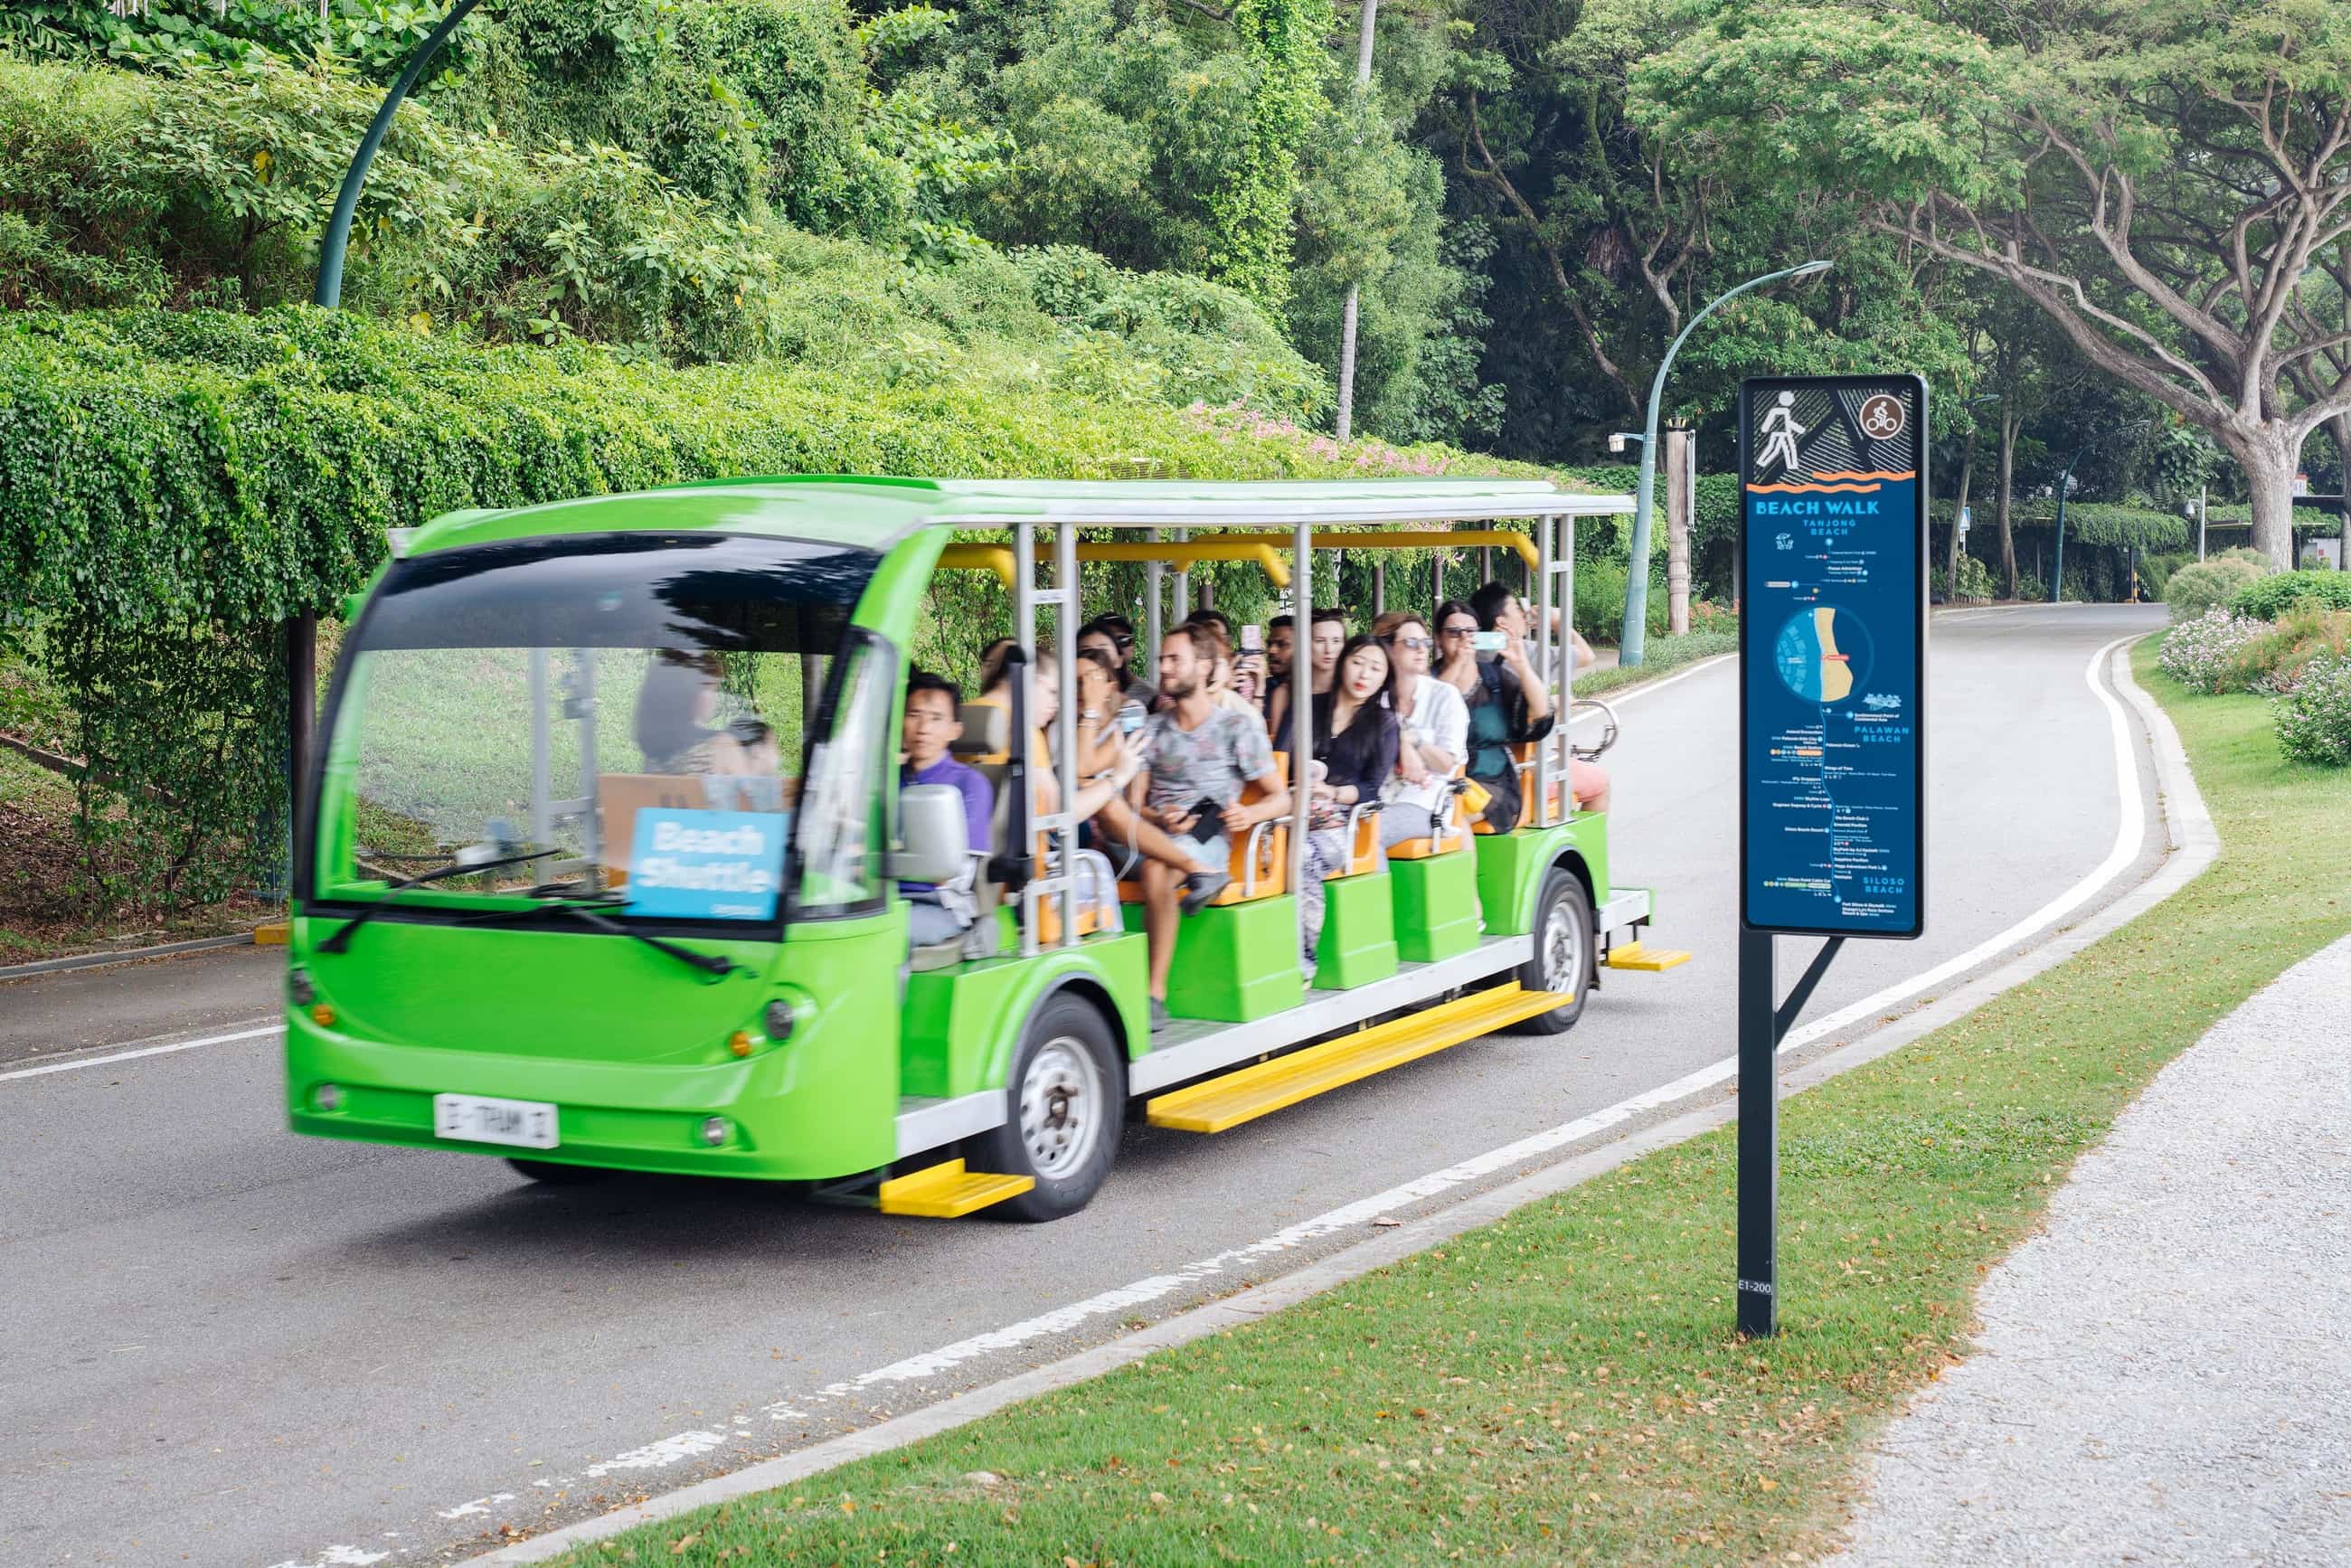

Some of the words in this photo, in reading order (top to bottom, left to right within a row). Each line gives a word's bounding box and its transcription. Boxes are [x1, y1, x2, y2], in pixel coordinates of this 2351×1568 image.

[1755, 501, 1819, 515] BEACH
[1825, 501, 1880, 515] WALK
[1802, 519, 1856, 527] TANJONG
[1854, 726, 1910, 734] PALAWAN
[1863, 734, 1901, 742] BEACH
[652, 821, 764, 855] Beach
[636, 857, 772, 893] Shuttle
[1863, 876, 1904, 885] SILOSO
[1865, 885, 1903, 894] BEACH
[1738, 1280, 1771, 1293] E1-200
